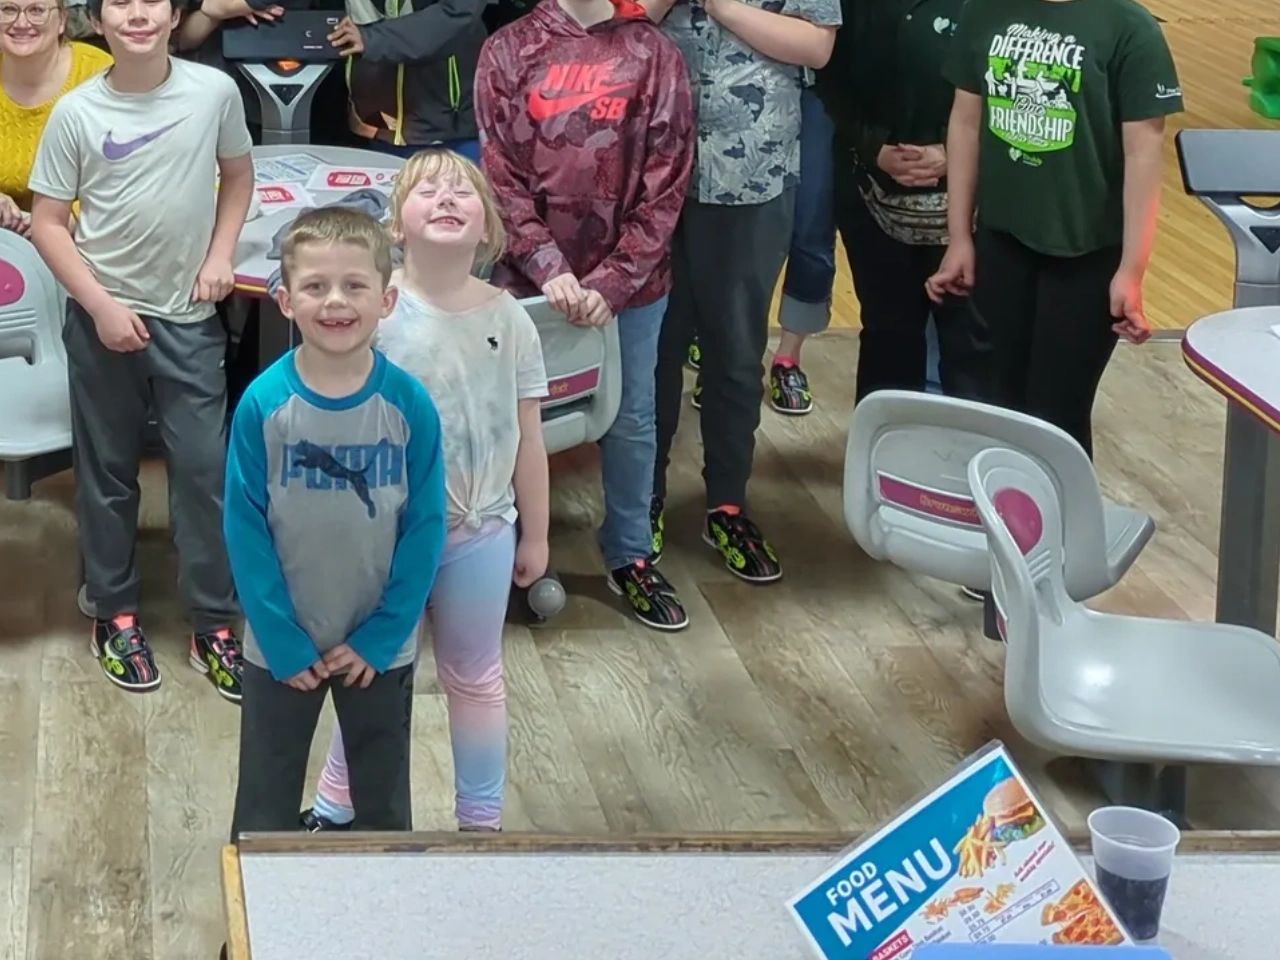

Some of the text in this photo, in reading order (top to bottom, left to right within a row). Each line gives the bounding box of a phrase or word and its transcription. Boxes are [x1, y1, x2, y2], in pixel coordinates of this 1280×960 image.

[989, 34, 1086, 70] DIFFERENCE
[1006, 24, 1077, 44] Making a
[542, 59, 614, 92] NIKE
[590, 96, 628, 120] SB
[1014, 94, 1046, 117] One
[990, 106, 1074, 142] FRIENDSHIP
[280, 443, 404, 491] PUMA
[826, 861, 878, 907] FOOD
[826, 837, 953, 947] MENU
